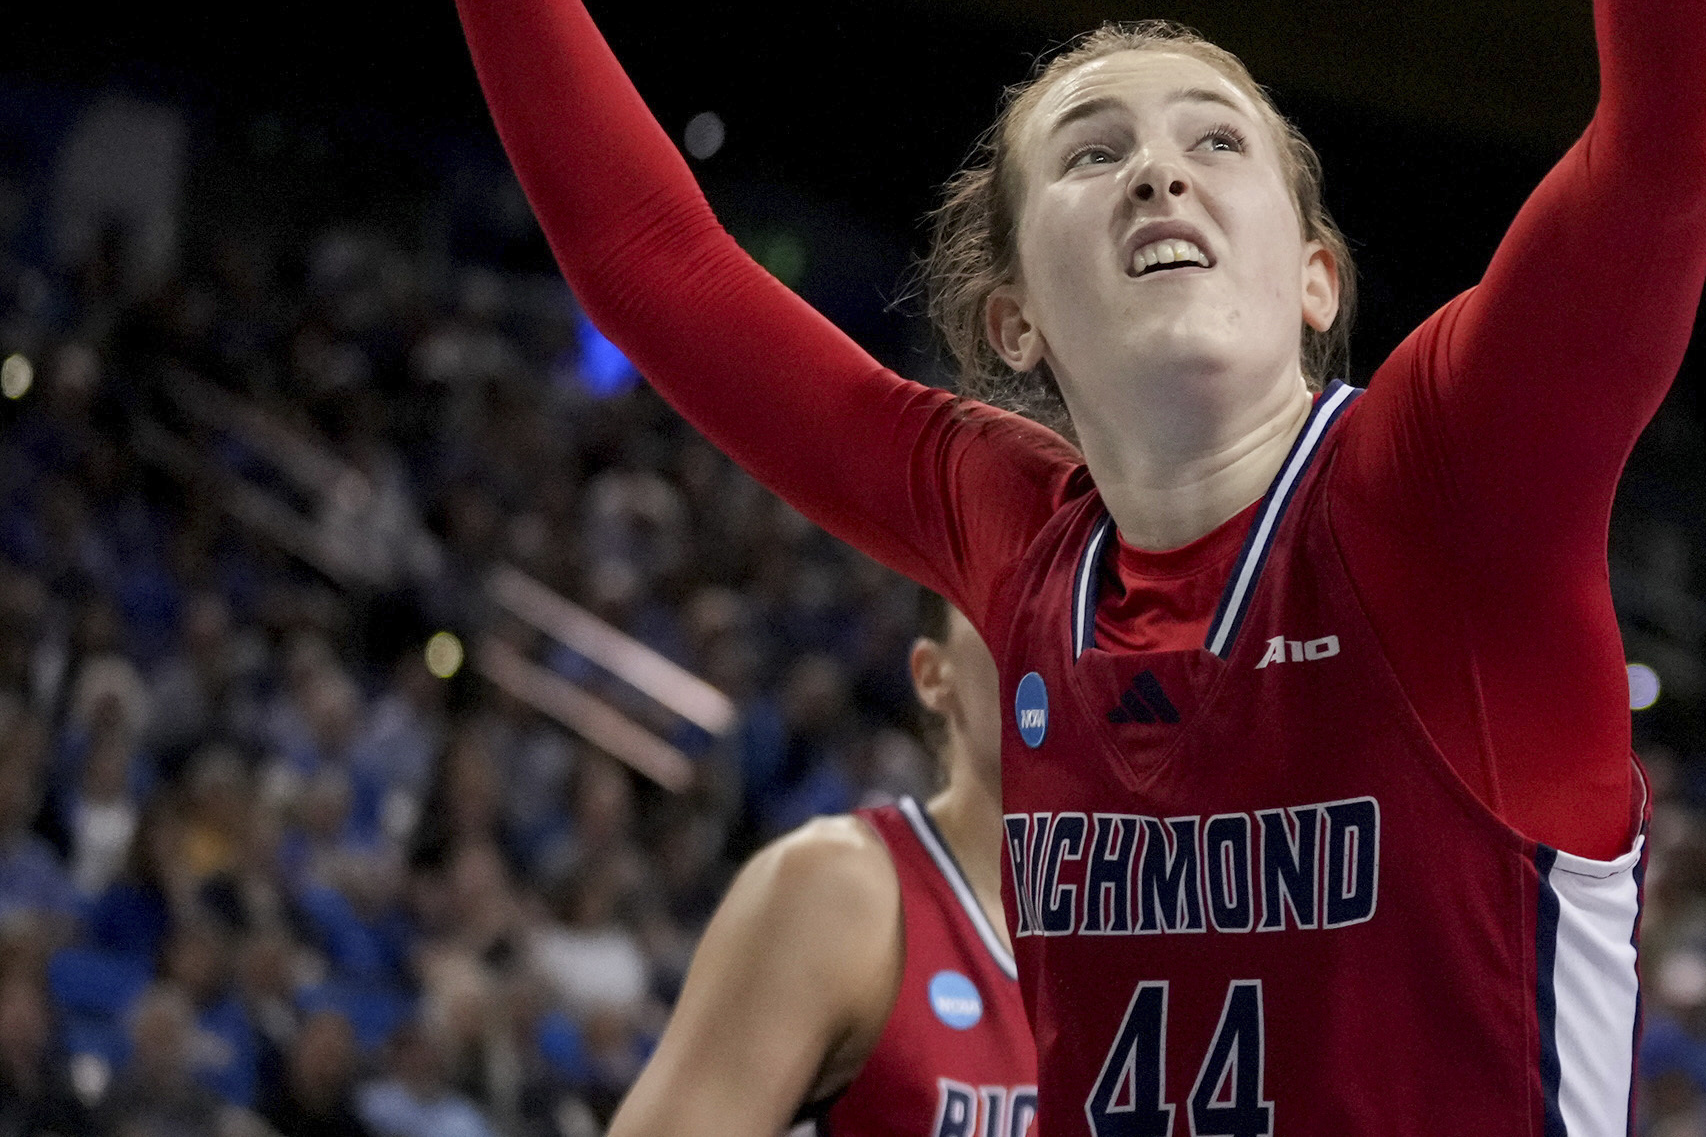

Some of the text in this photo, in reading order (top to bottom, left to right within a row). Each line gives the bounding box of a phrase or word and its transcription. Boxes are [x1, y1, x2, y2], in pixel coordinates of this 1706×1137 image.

[1254, 635, 1340, 670] A10
[1003, 795, 1380, 938] RICHMOND
[1085, 978, 1276, 1137] 44
